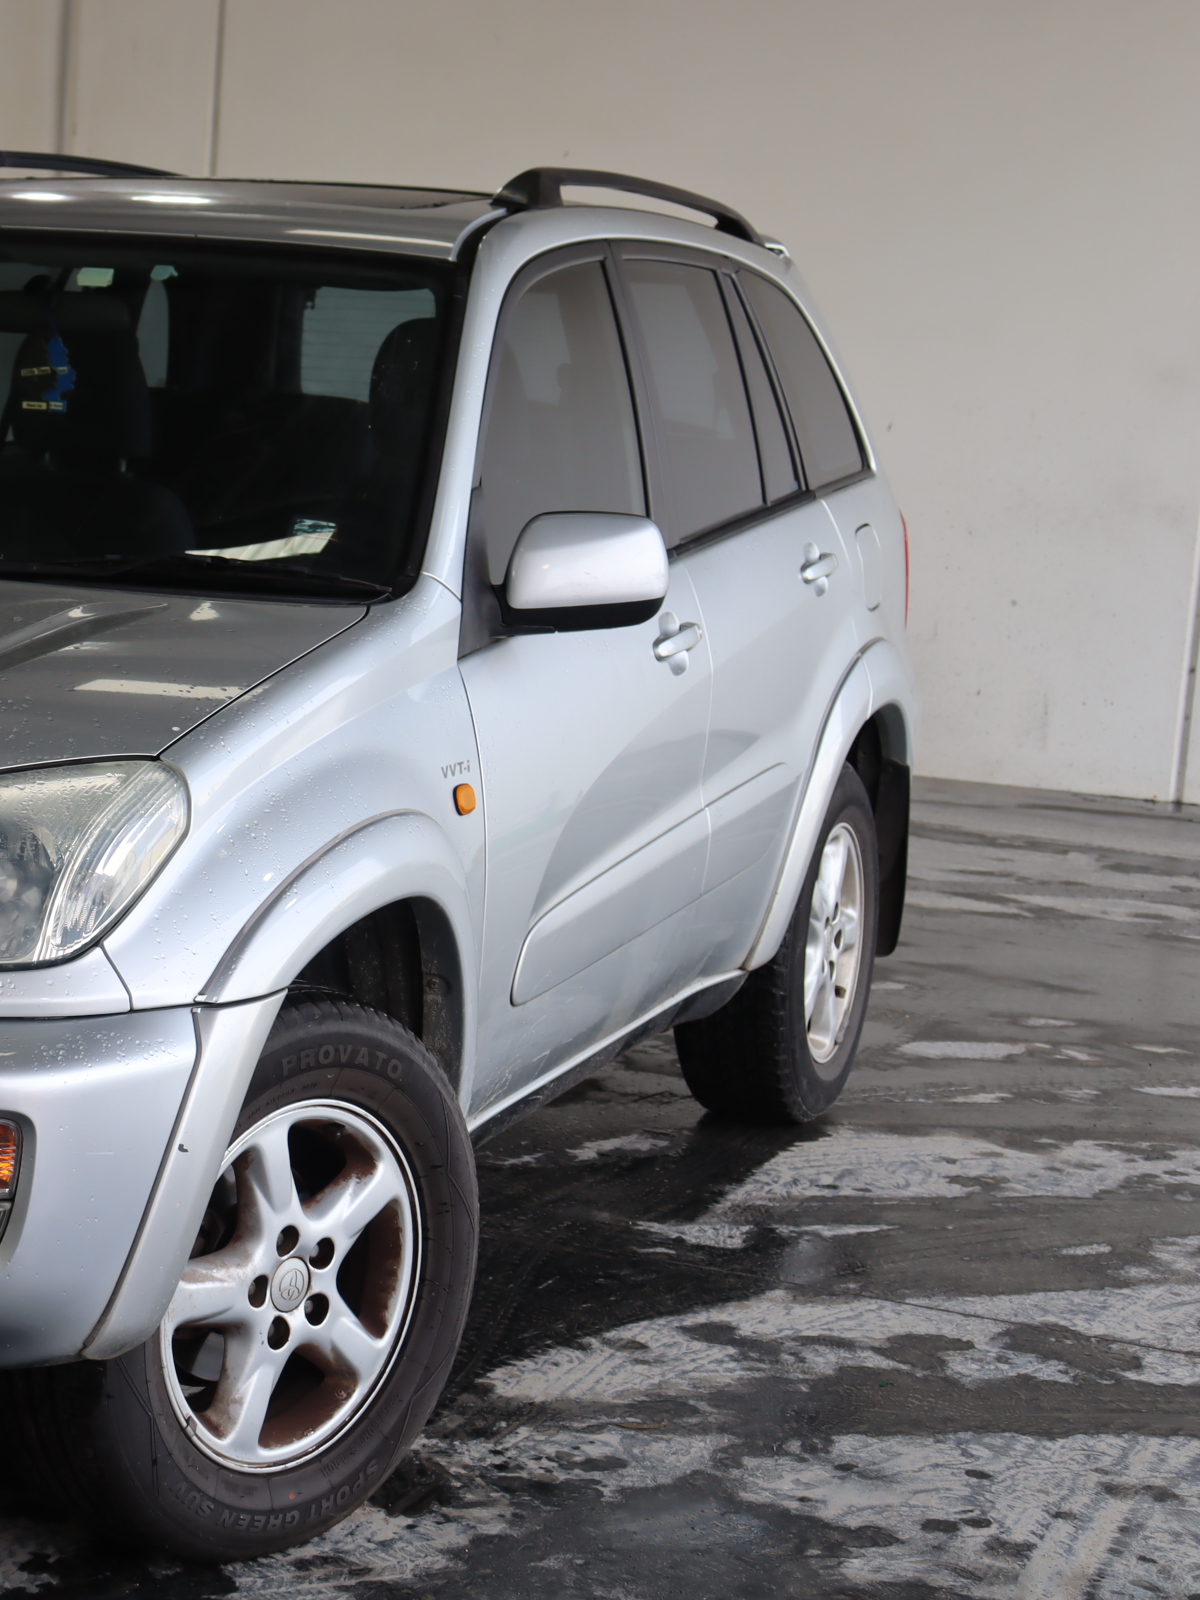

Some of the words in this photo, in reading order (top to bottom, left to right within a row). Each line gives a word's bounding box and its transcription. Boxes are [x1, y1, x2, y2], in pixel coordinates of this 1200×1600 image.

[281, 1045, 402, 1080] PROVATO
[321, 1453, 347, 1478] 100H
[167, 1482, 215, 1519] SUV
[308, 1458, 379, 1520] SPORT
[216, 1509, 301, 1534] GREEN
